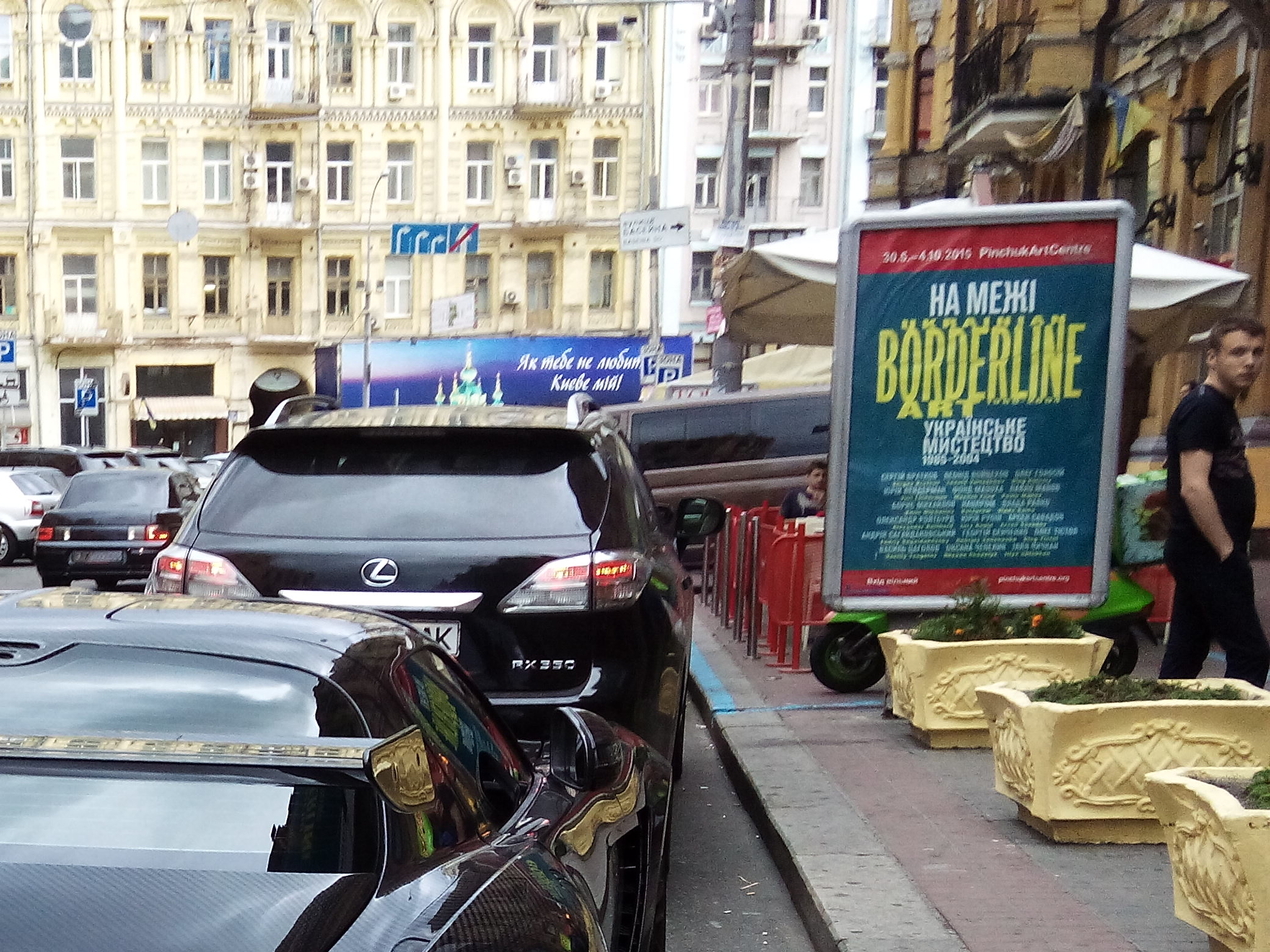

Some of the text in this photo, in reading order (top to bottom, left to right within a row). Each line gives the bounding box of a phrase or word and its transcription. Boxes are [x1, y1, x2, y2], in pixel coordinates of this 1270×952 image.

[929, 279, 1038, 317] НА МЕЖІ
[517, 353, 537, 371] Як
[540, 347, 573, 371] тебе
[576, 355, 592, 370] не
[875, 318, 1087, 404] BORDERLINE
[550, 372, 624, 392] Києве мій!
[663, 368, 677, 383] P
[923, 415, 1028, 438] УКРАЇНСЬКЕ
[922, 434, 1027, 456] МИСТЕЦТВО
[511, 659, 576, 671] RX 350
